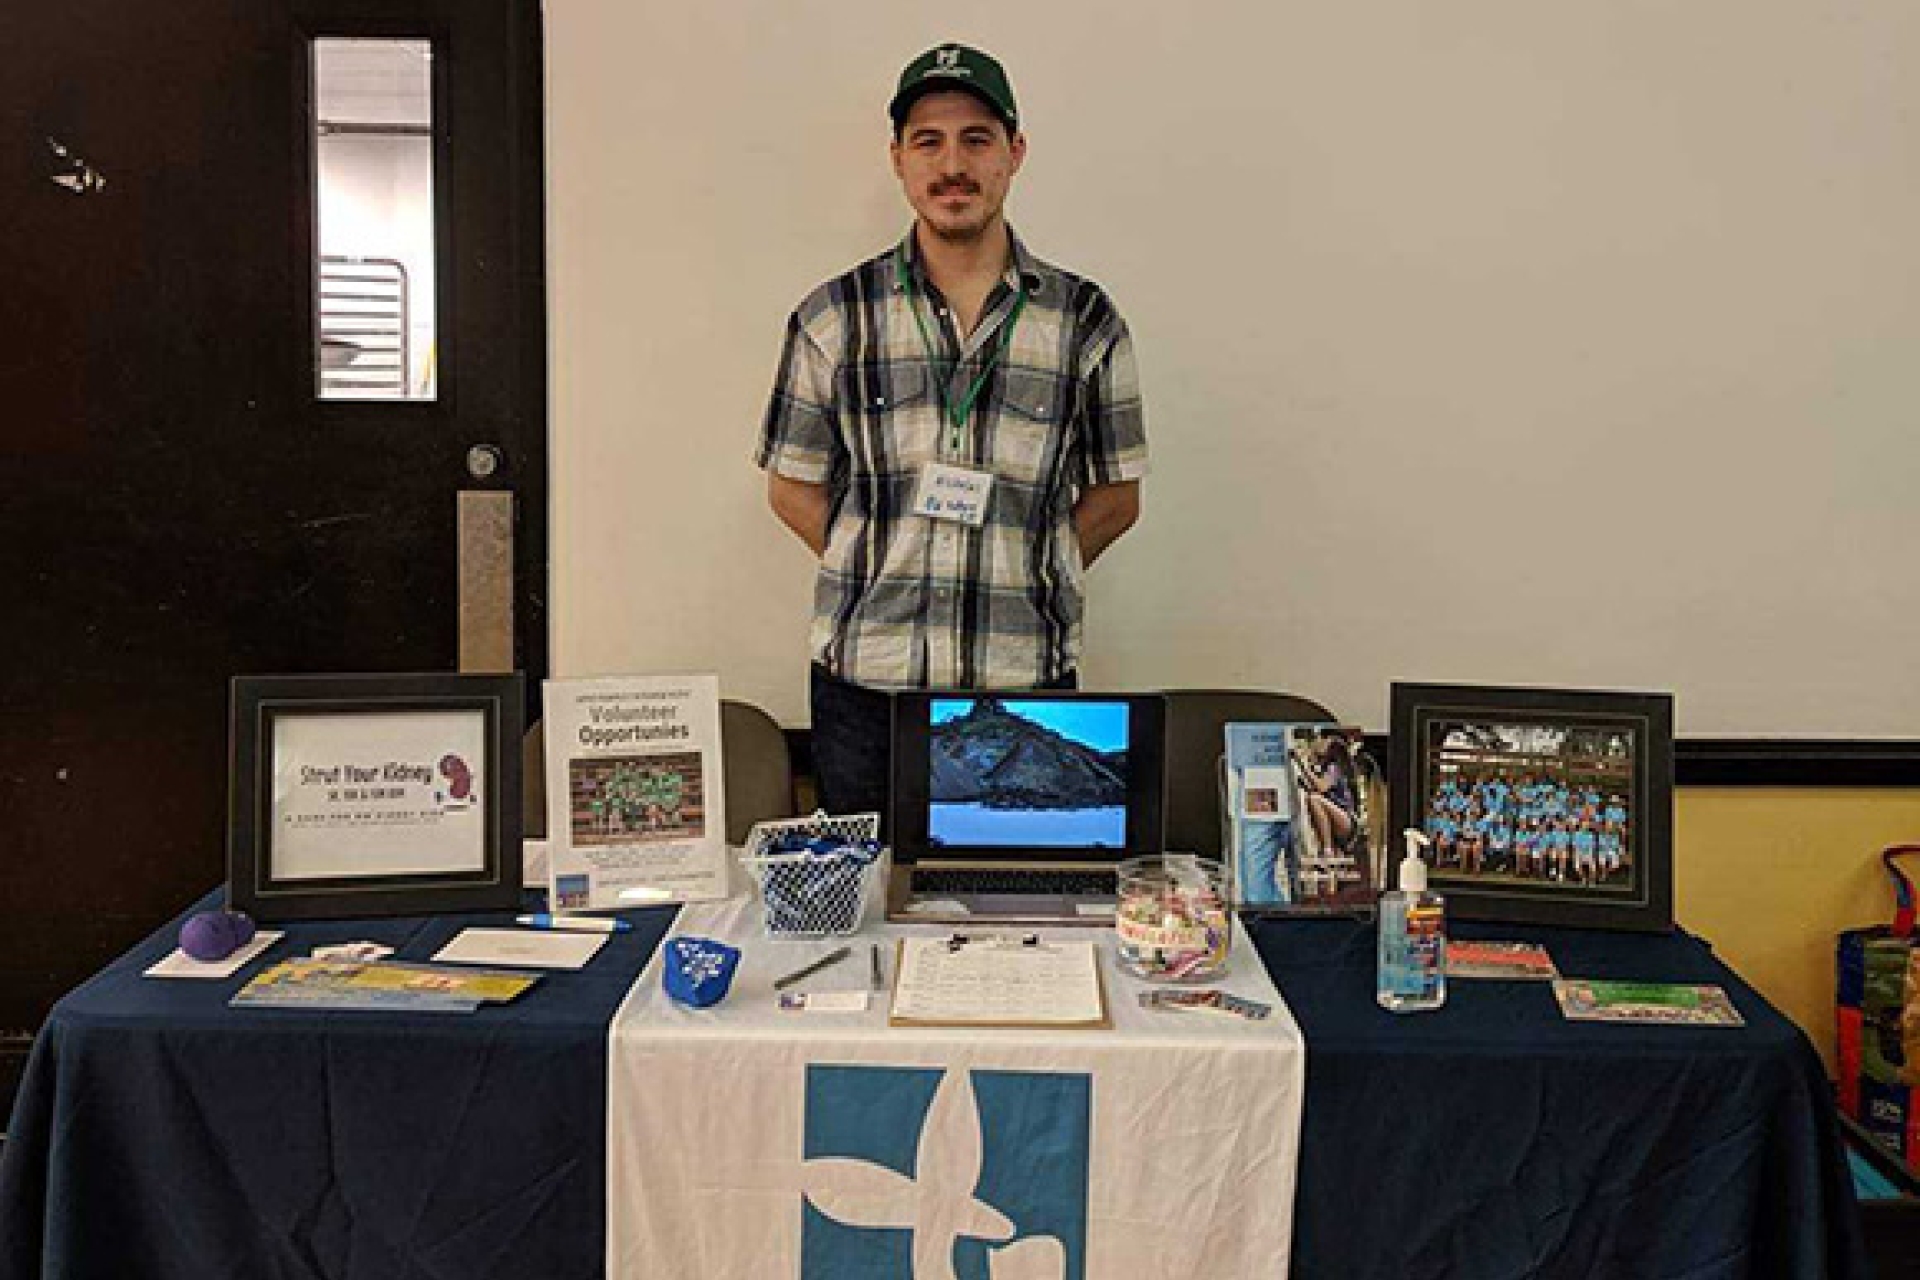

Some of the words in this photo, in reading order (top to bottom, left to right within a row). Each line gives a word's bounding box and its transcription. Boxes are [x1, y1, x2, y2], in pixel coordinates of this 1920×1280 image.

[588, 704, 678, 723] Volunteer
[300, 764, 341, 786] Strut
[343, 764, 379, 785] Your
[382, 761, 434, 786] Kidney
